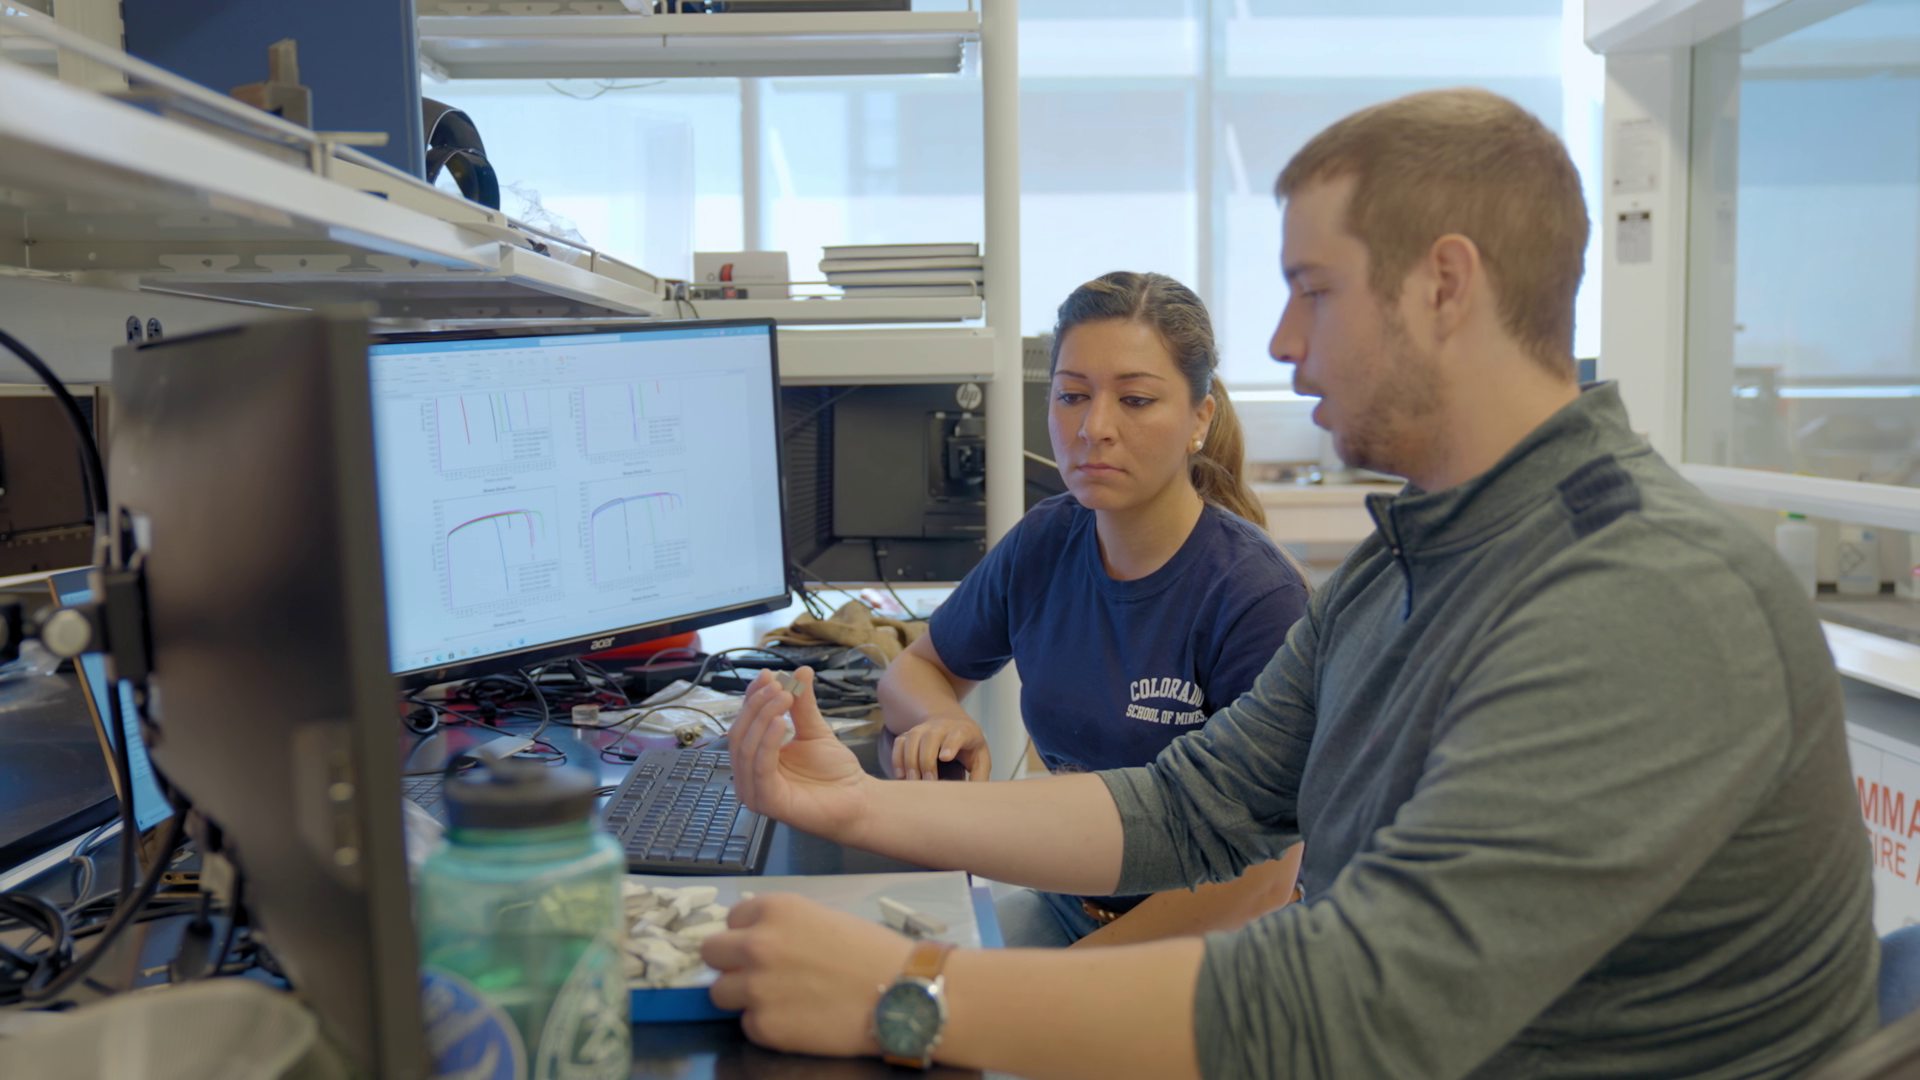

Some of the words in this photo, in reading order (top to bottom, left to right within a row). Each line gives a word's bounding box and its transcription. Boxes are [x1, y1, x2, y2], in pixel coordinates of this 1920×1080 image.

[959, 384, 980, 409] hp
[590, 636, 615, 650] acer
[1125, 703, 1160, 723] SCHOOL
[1160, 709, 1174, 725] OF
[1174, 709, 1205, 725] MINES
[1867, 828, 1906, 879] IRE
